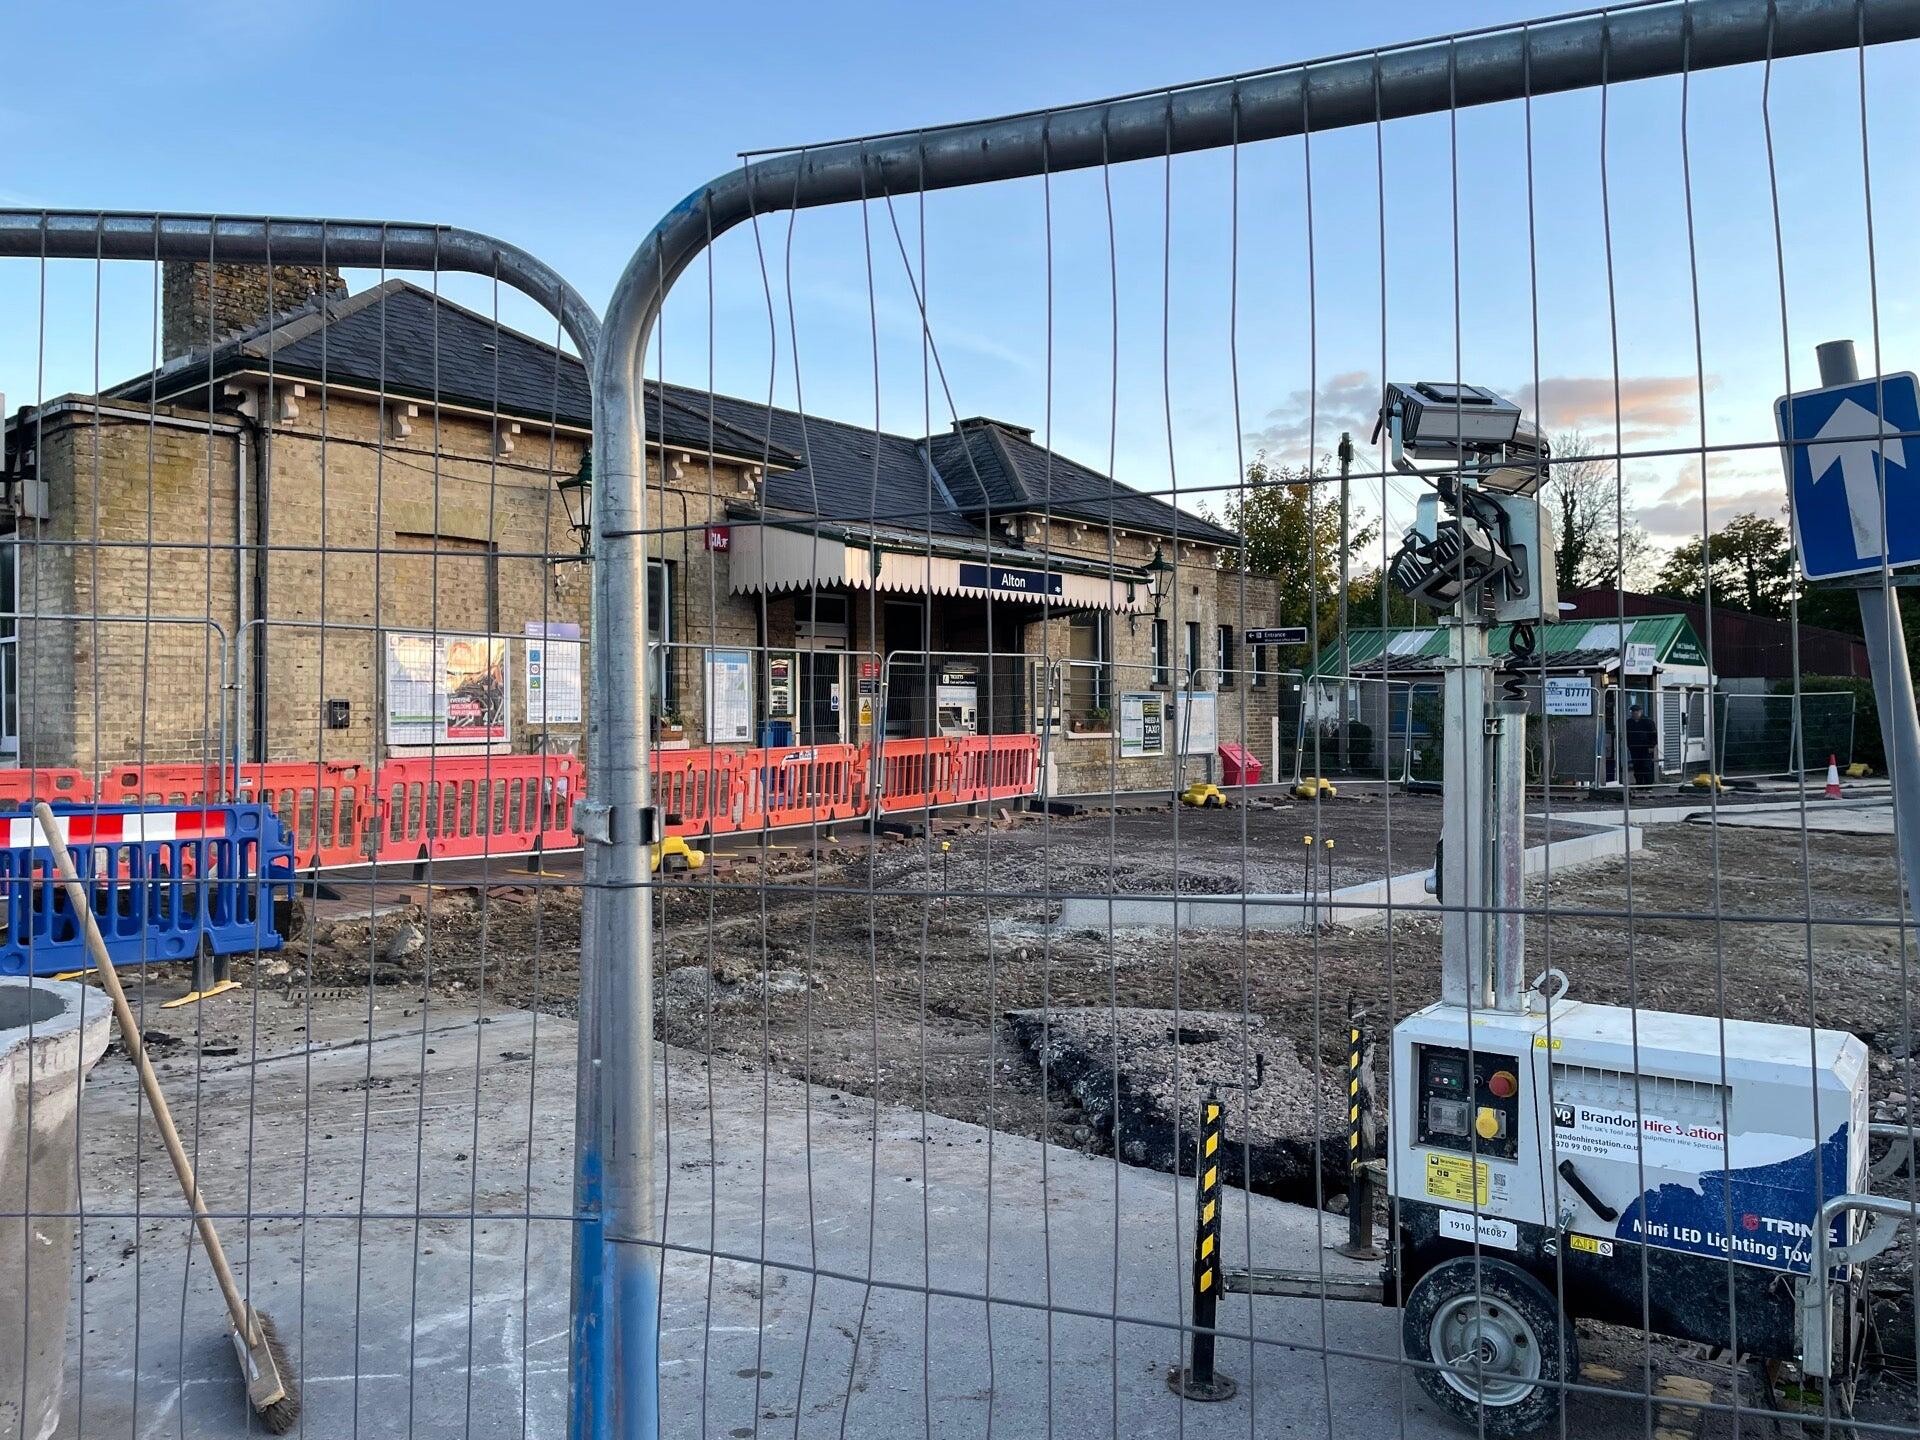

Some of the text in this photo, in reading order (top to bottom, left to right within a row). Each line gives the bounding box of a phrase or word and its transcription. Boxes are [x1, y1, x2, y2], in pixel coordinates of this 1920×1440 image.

[1001, 573, 1026, 588] Alton
[1565, 687, 1590, 697] 87777
[1144, 716, 1156, 724] NEED
[1144, 725, 1160, 734] TAXI?
[1554, 1107, 1571, 1122] Vp
[1582, 1124, 1594, 1132] The
[1610, 1128, 1624, 1136] Tool
[1642, 1134, 1676, 1144] quipment
[1643, 1120, 1672, 1134] Hire
[1554, 1132, 1640, 1151] randonhirestation.co.u
[1554, 1141, 1569, 1149] 370
[1582, 1144, 1592, 1152] 00
[1594, 1146, 1608, 1154] 999
[1633, 1218, 1812, 1264] Mini LED Lighting Tow
